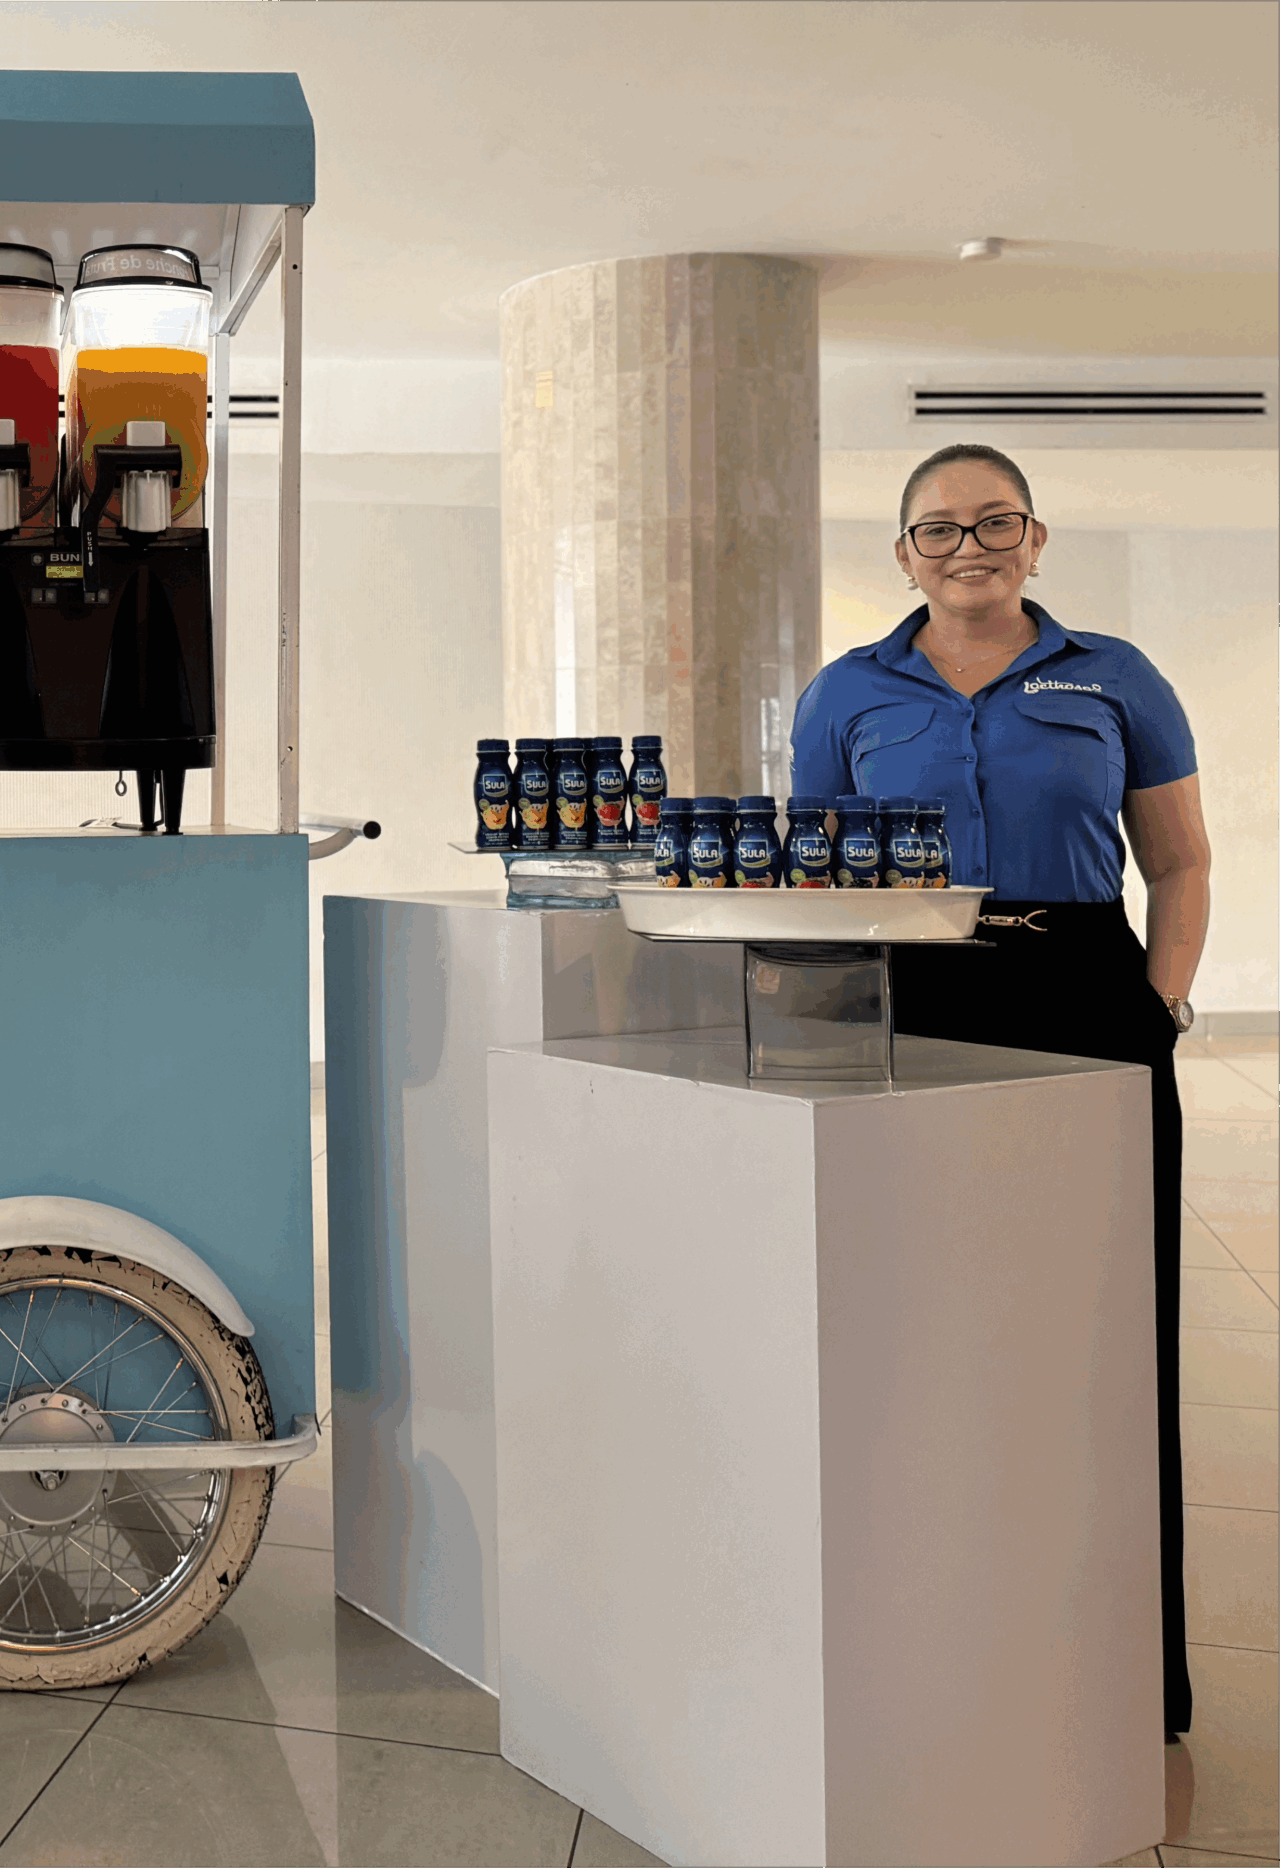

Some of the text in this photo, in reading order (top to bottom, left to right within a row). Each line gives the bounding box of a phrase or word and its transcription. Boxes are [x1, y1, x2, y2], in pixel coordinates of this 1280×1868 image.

[50, 554, 80, 562] BUN
[526, 780, 547, 789] SULA
[565, 780, 585, 789] SULA
[600, 776, 621, 785] SULA
[639, 776, 661, 786] SULA
[485, 781, 505, 790] SULA
[655, 849, 669, 857] ULA
[693, 848, 718, 858] SULA
[741, 848, 766, 858] SULA
[802, 846, 826, 857] SULA
[848, 847, 874, 857] SULA
